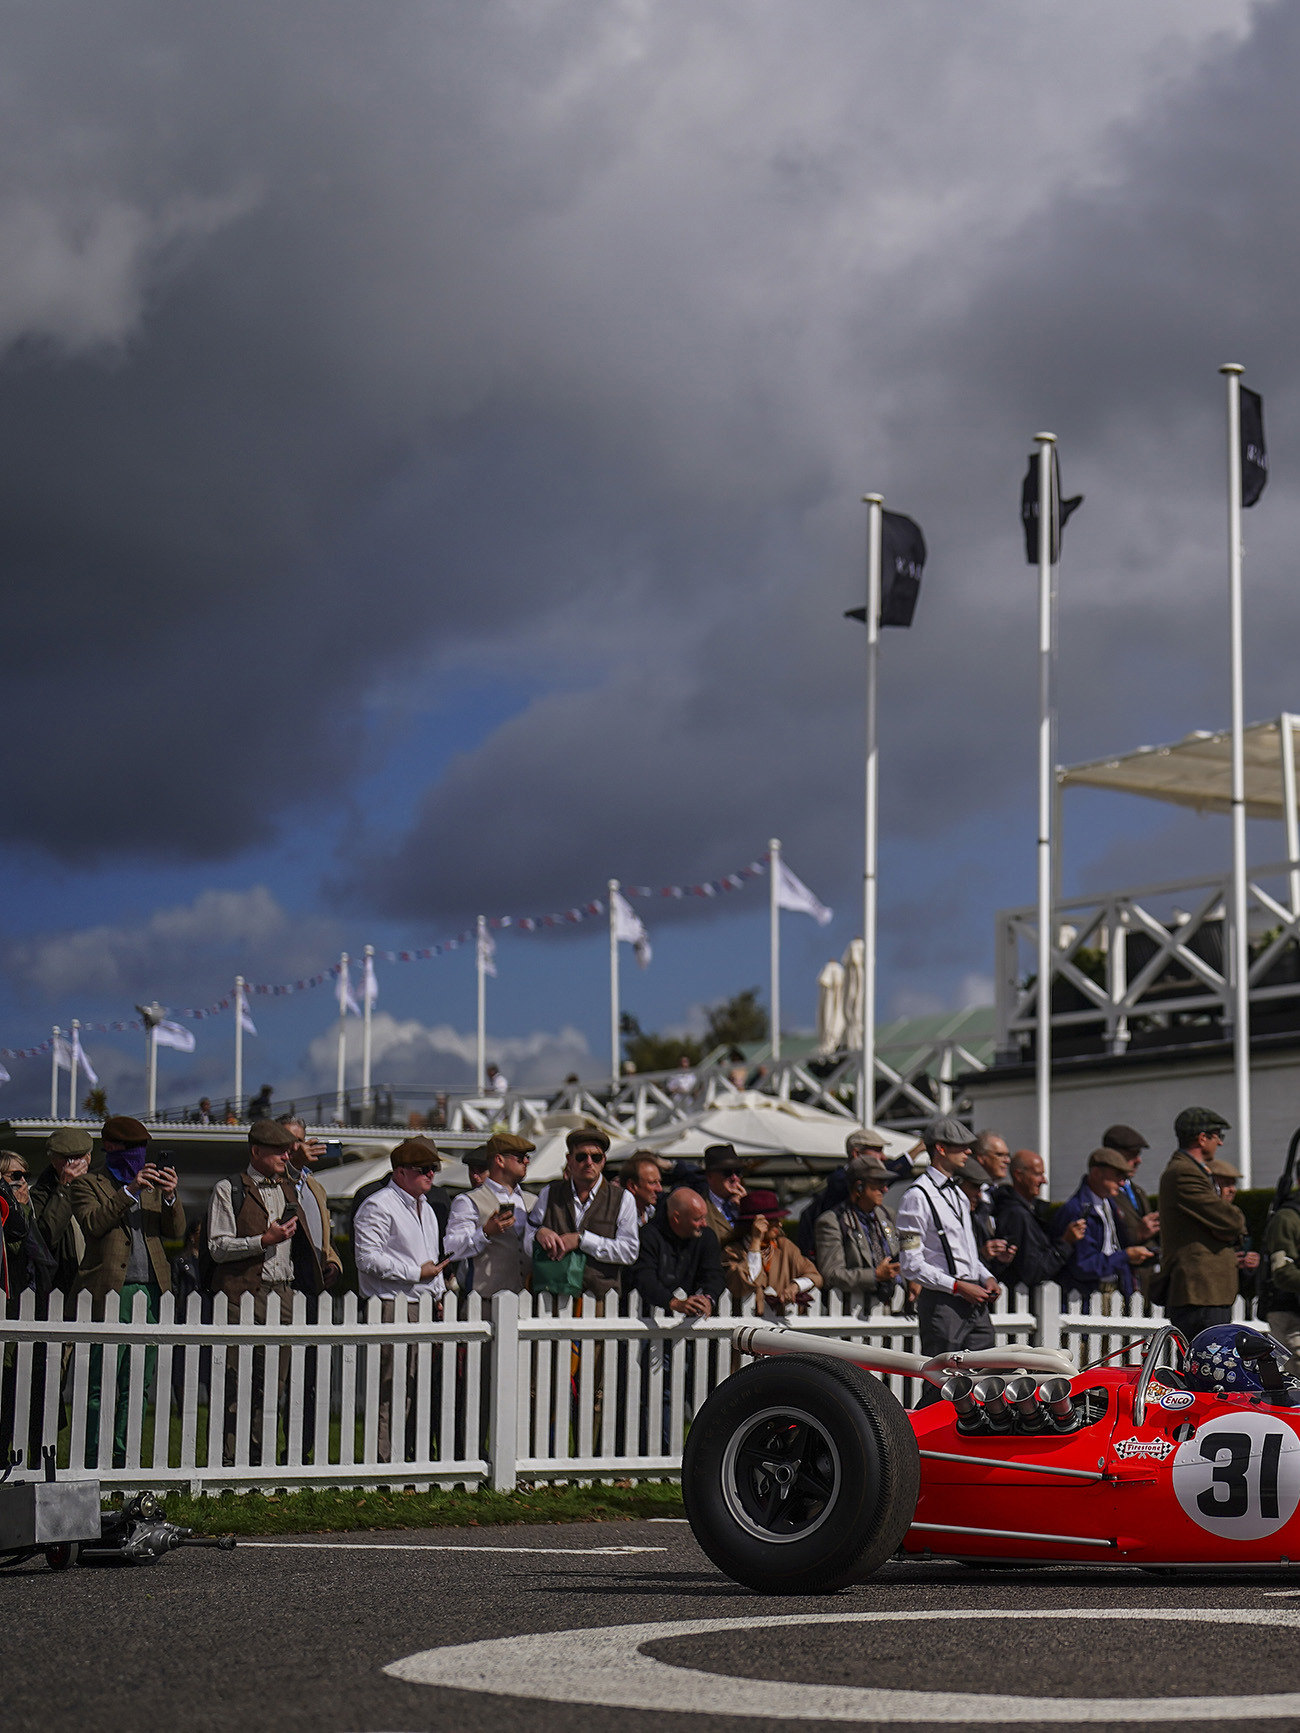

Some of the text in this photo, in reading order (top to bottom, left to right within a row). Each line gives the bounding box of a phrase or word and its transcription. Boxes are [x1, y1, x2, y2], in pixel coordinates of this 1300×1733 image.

[1165, 1395, 1190, 1405] ENCO
[1127, 1443, 1162, 1452] Firestone
[1196, 1432, 1284, 1519] 31
